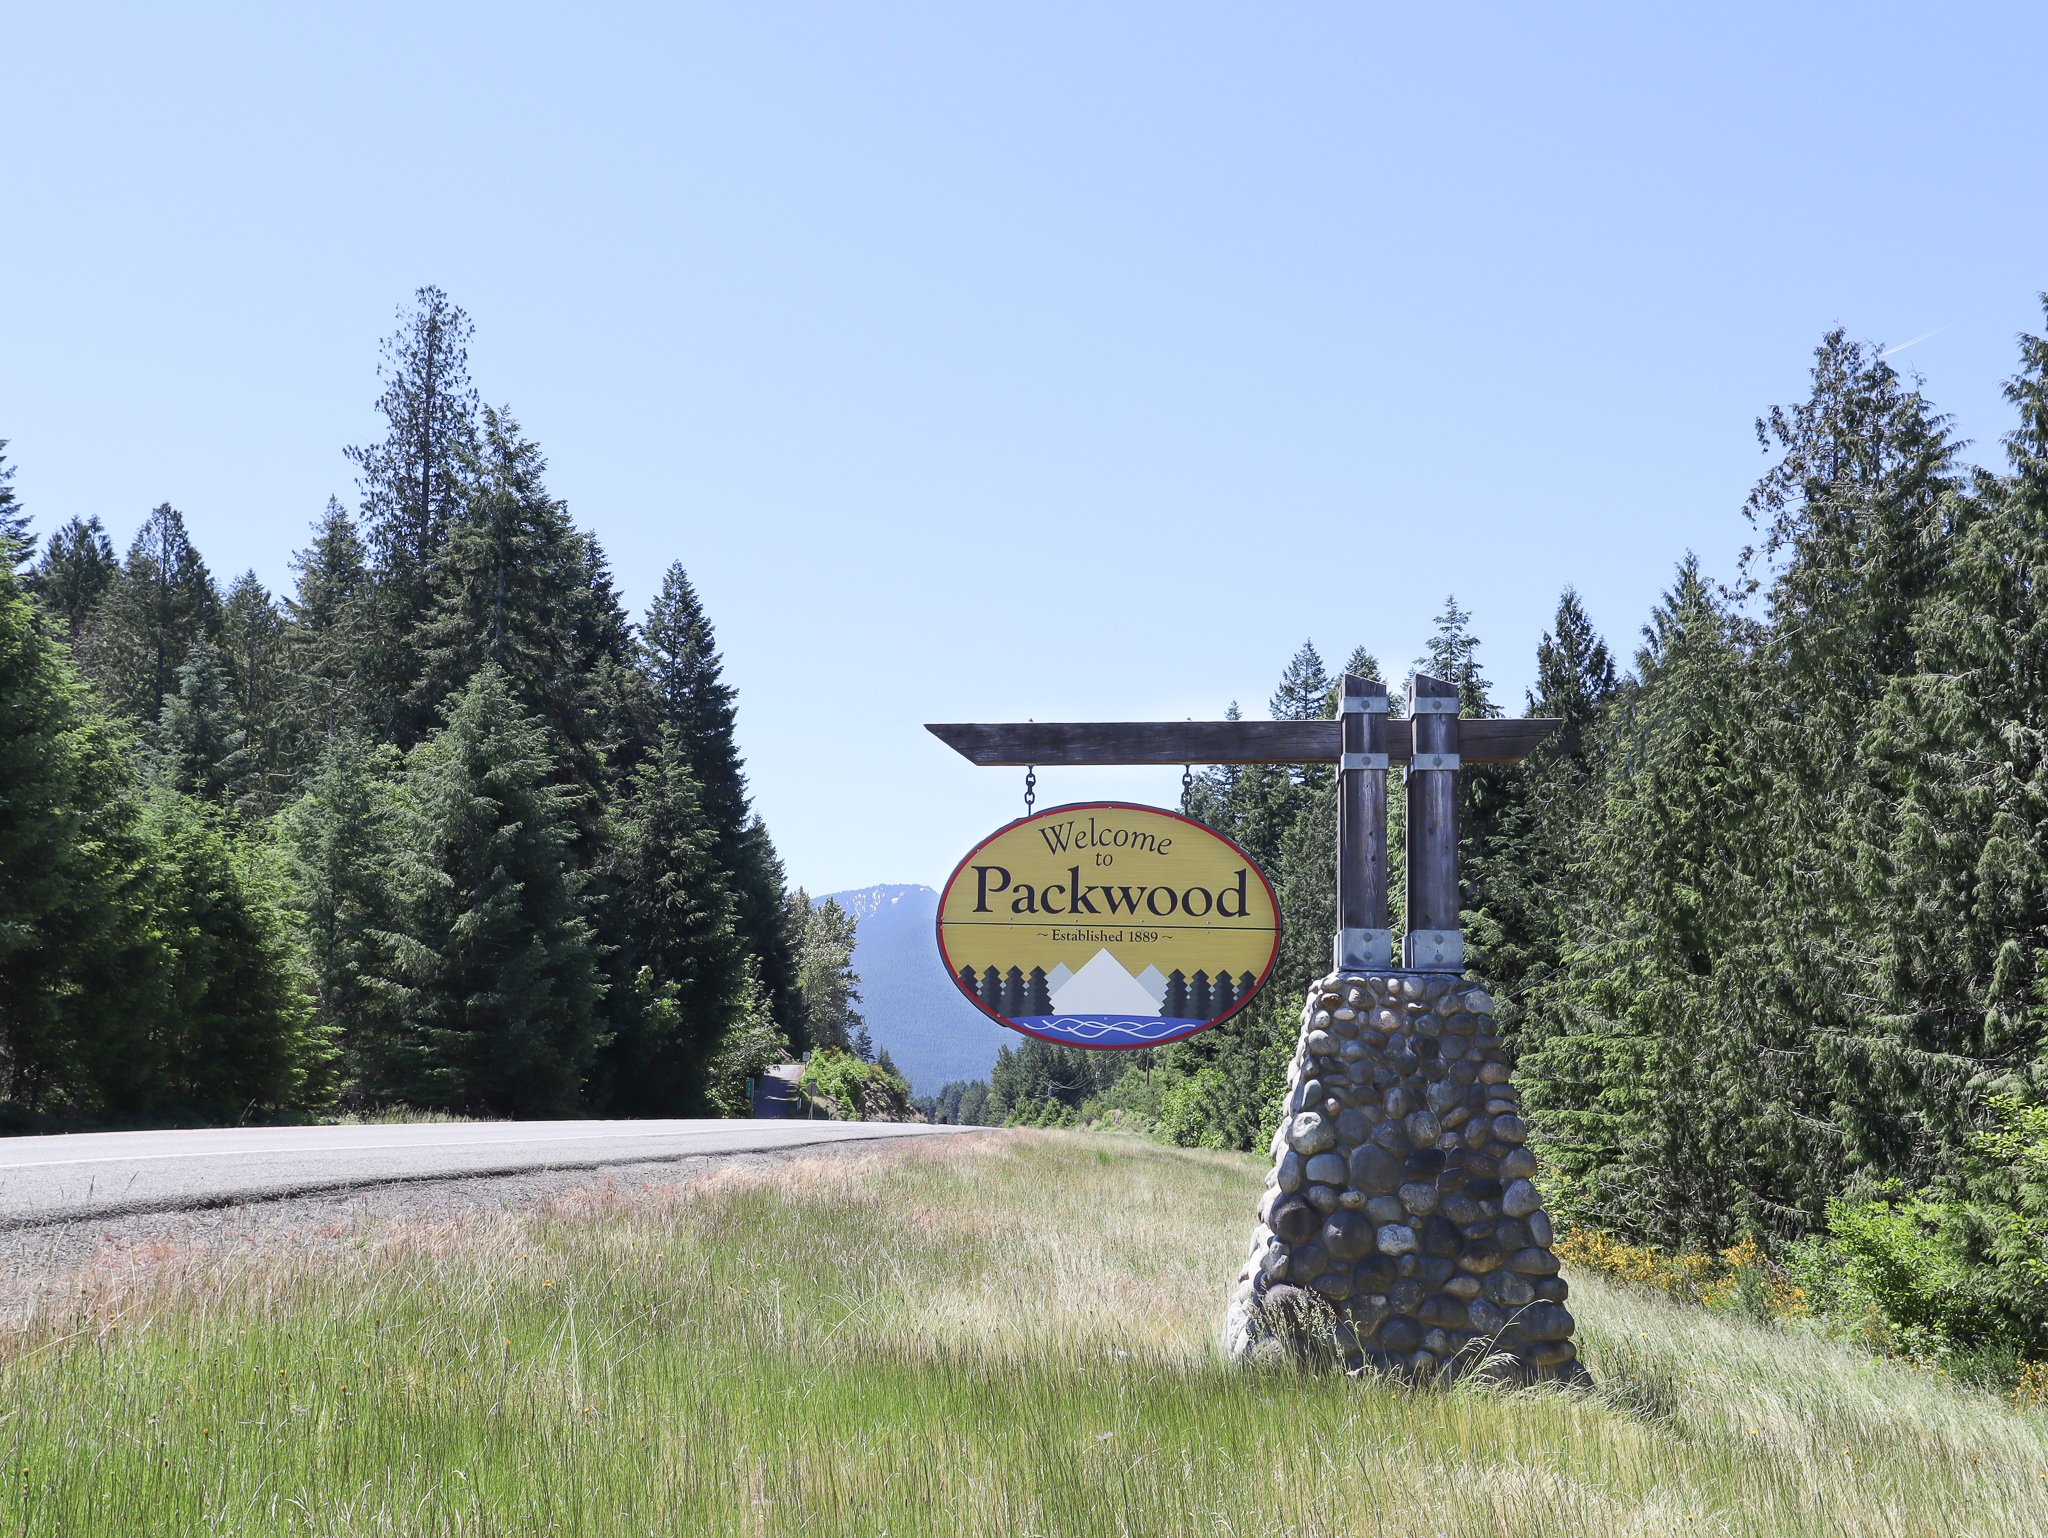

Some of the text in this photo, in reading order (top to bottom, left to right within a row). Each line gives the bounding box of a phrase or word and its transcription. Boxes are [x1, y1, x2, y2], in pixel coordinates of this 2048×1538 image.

[1038, 817, 1173, 856] Welcome
[1095, 852, 1113, 867] to
[971, 865, 1251, 918] Packwood
[1052, 929, 1158, 943] Established 1889
